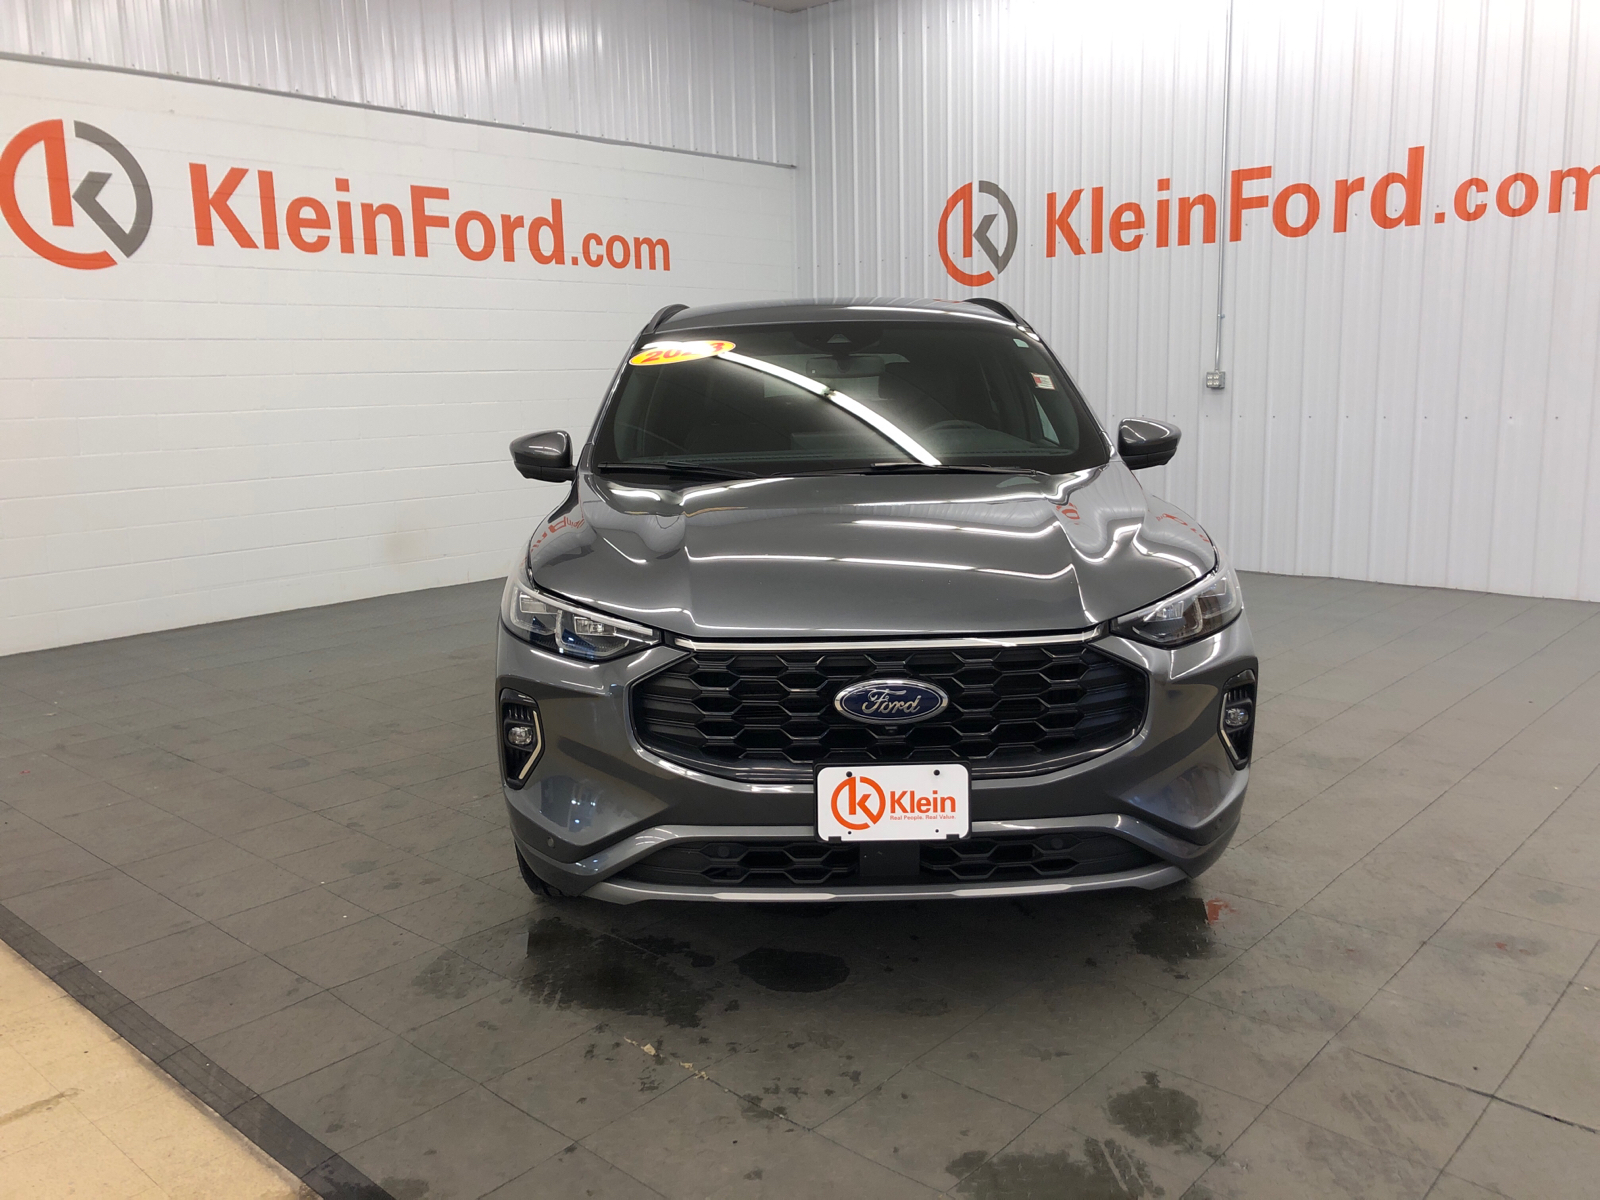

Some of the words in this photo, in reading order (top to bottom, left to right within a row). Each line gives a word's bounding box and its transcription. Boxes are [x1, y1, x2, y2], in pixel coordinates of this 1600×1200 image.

[188, 162, 671, 272] KleinFord.com
[1045, 146, 1600, 258] KleinFord.com
[861, 689, 922, 714] Ford
[890, 790, 956, 814] Klein
